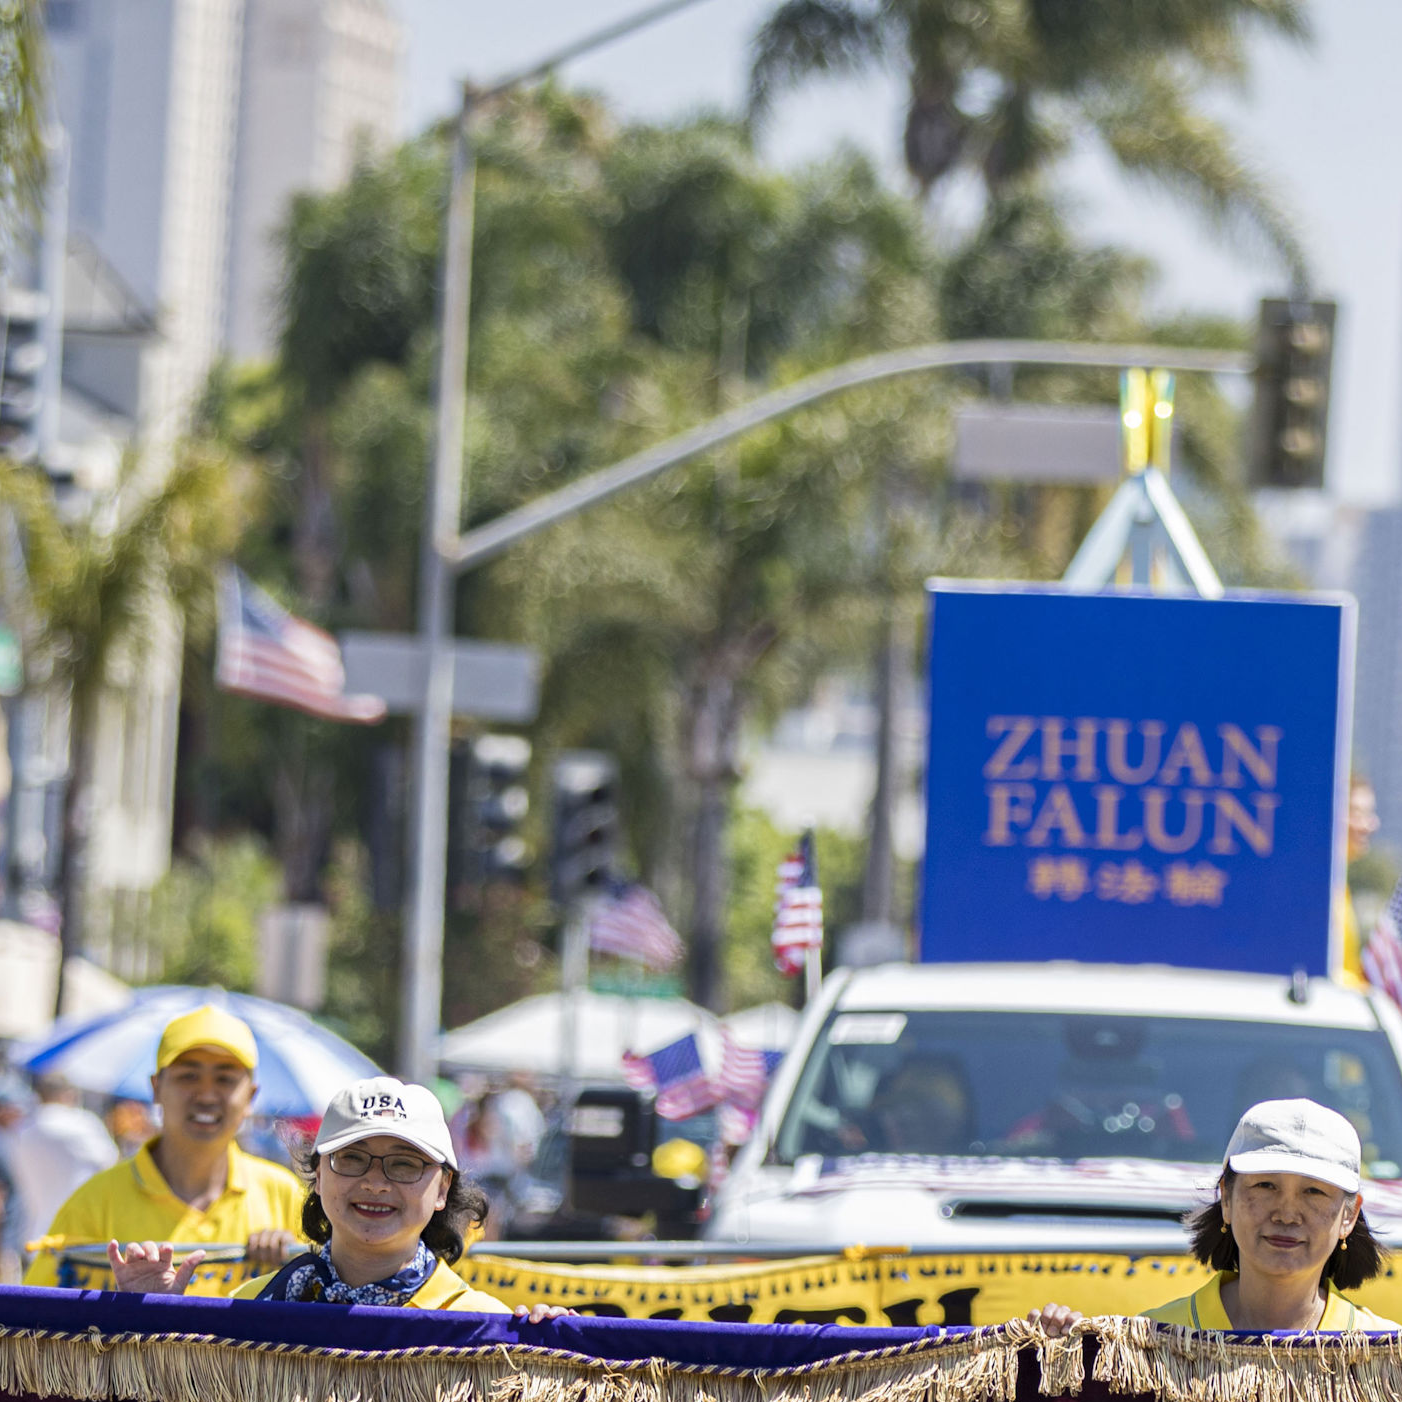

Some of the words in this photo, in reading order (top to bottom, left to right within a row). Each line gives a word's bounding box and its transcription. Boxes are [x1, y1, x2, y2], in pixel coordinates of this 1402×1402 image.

[985, 715, 1283, 788] ZHUAN
[985, 782, 1283, 858] FALUN
[363, 1095, 405, 1111] USA
